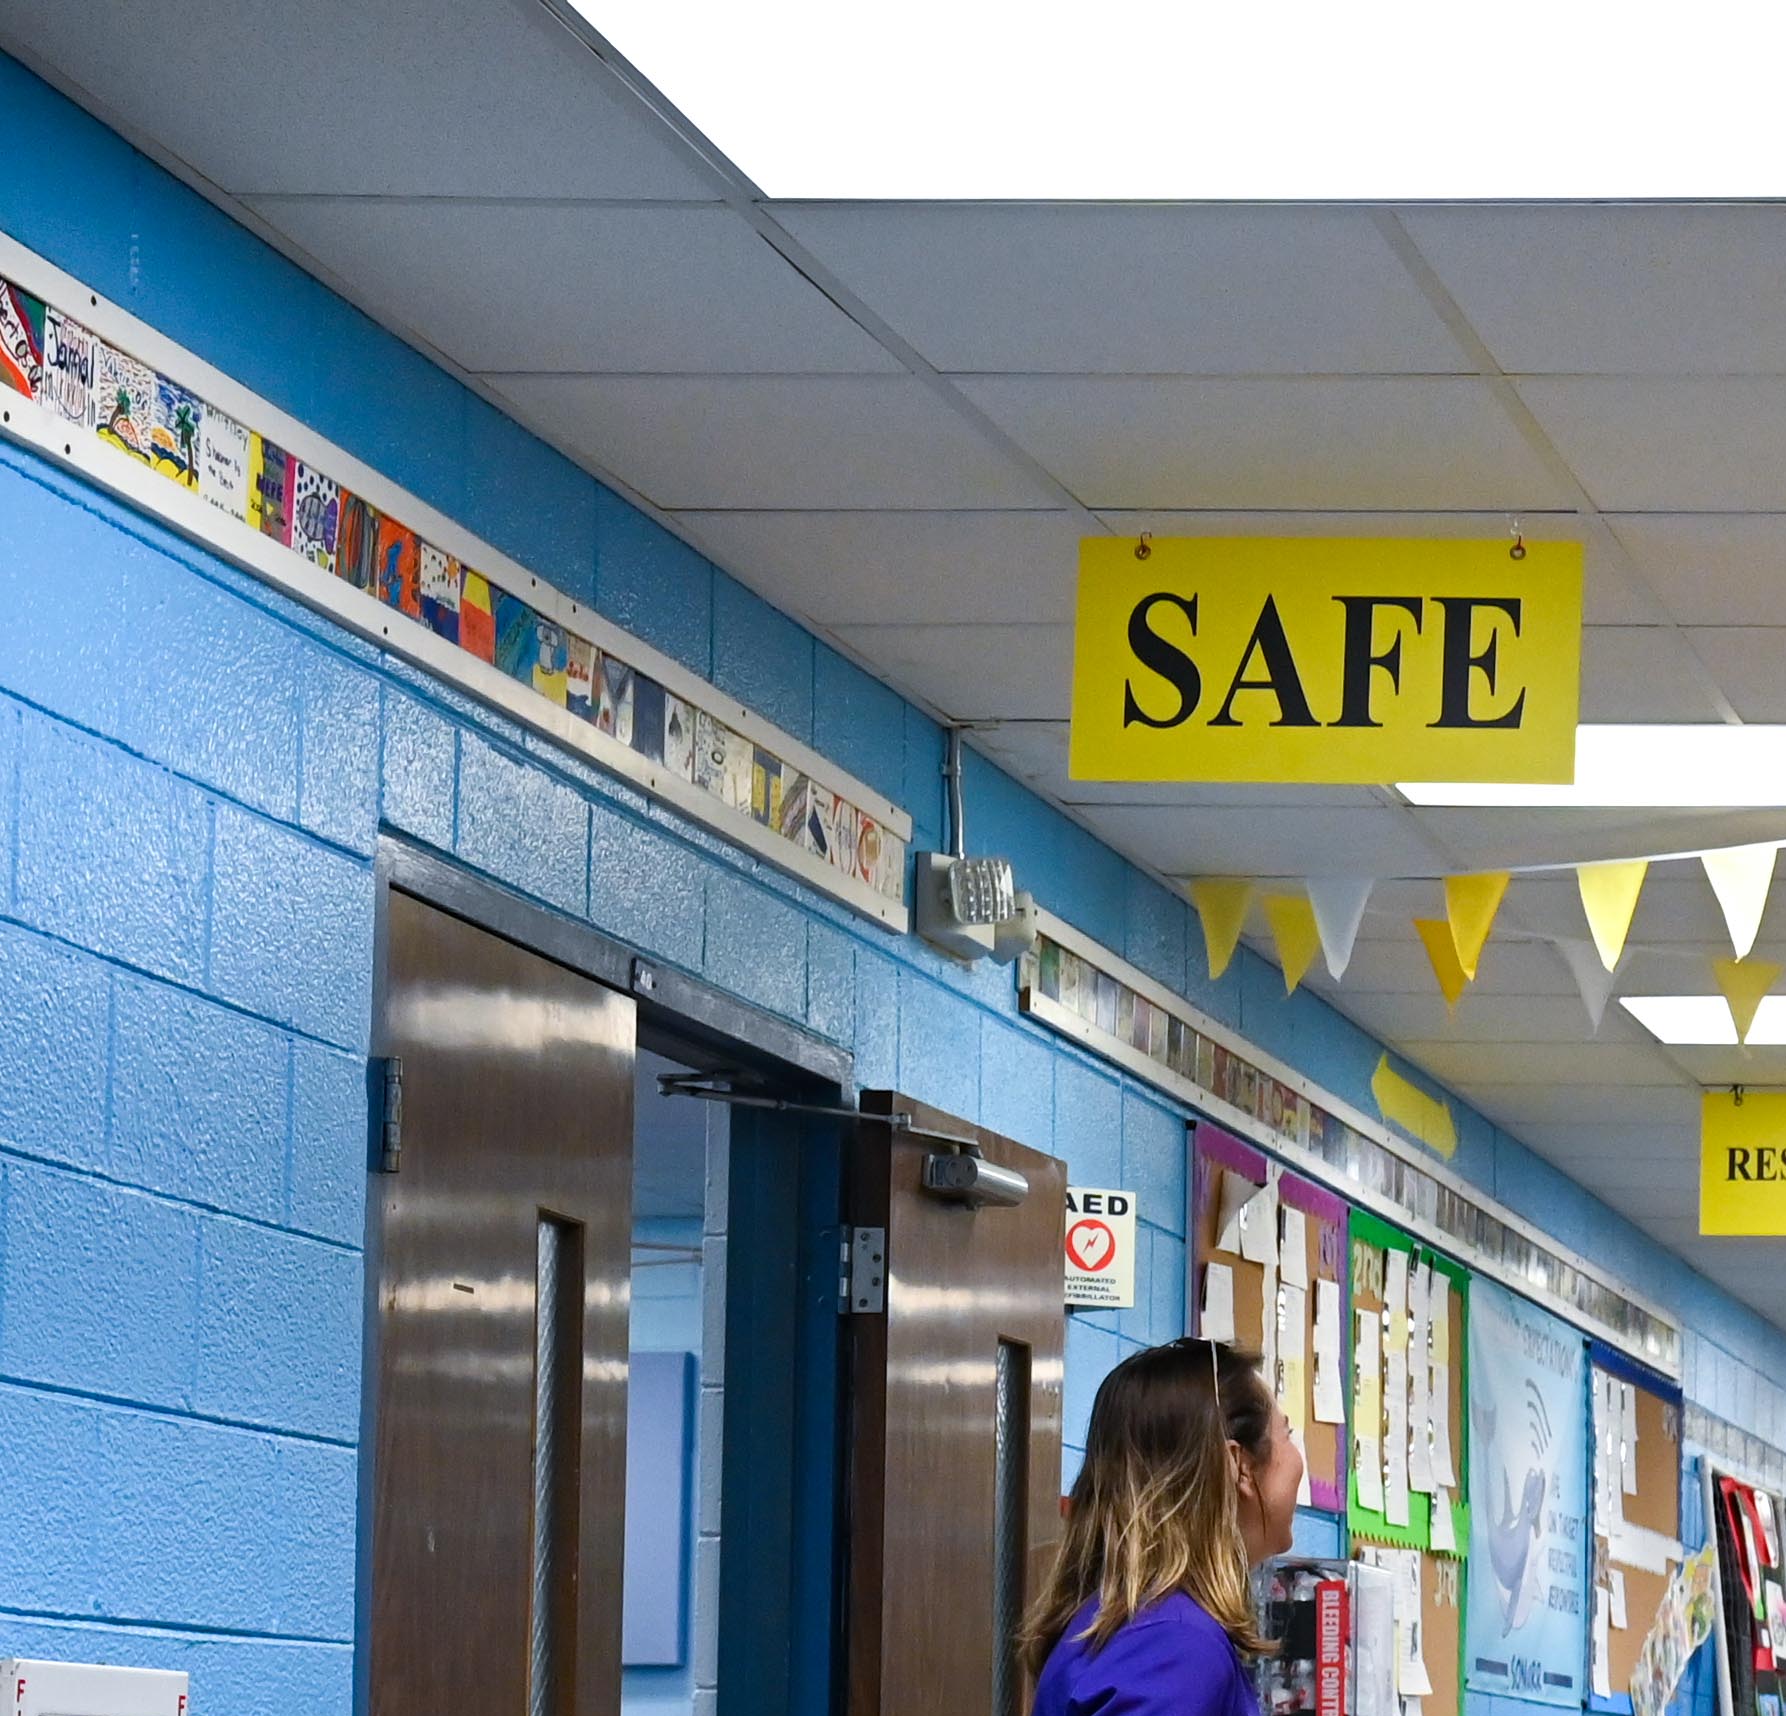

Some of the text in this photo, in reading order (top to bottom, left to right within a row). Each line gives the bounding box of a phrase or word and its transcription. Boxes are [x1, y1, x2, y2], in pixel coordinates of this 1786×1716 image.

[1123, 592, 1528, 729] SAFE
[1066, 1192, 1129, 1216] AED
[1067, 1284, 1110, 1293] EXTERNAL
[1321, 1590, 1340, 1664] BLEEDING
